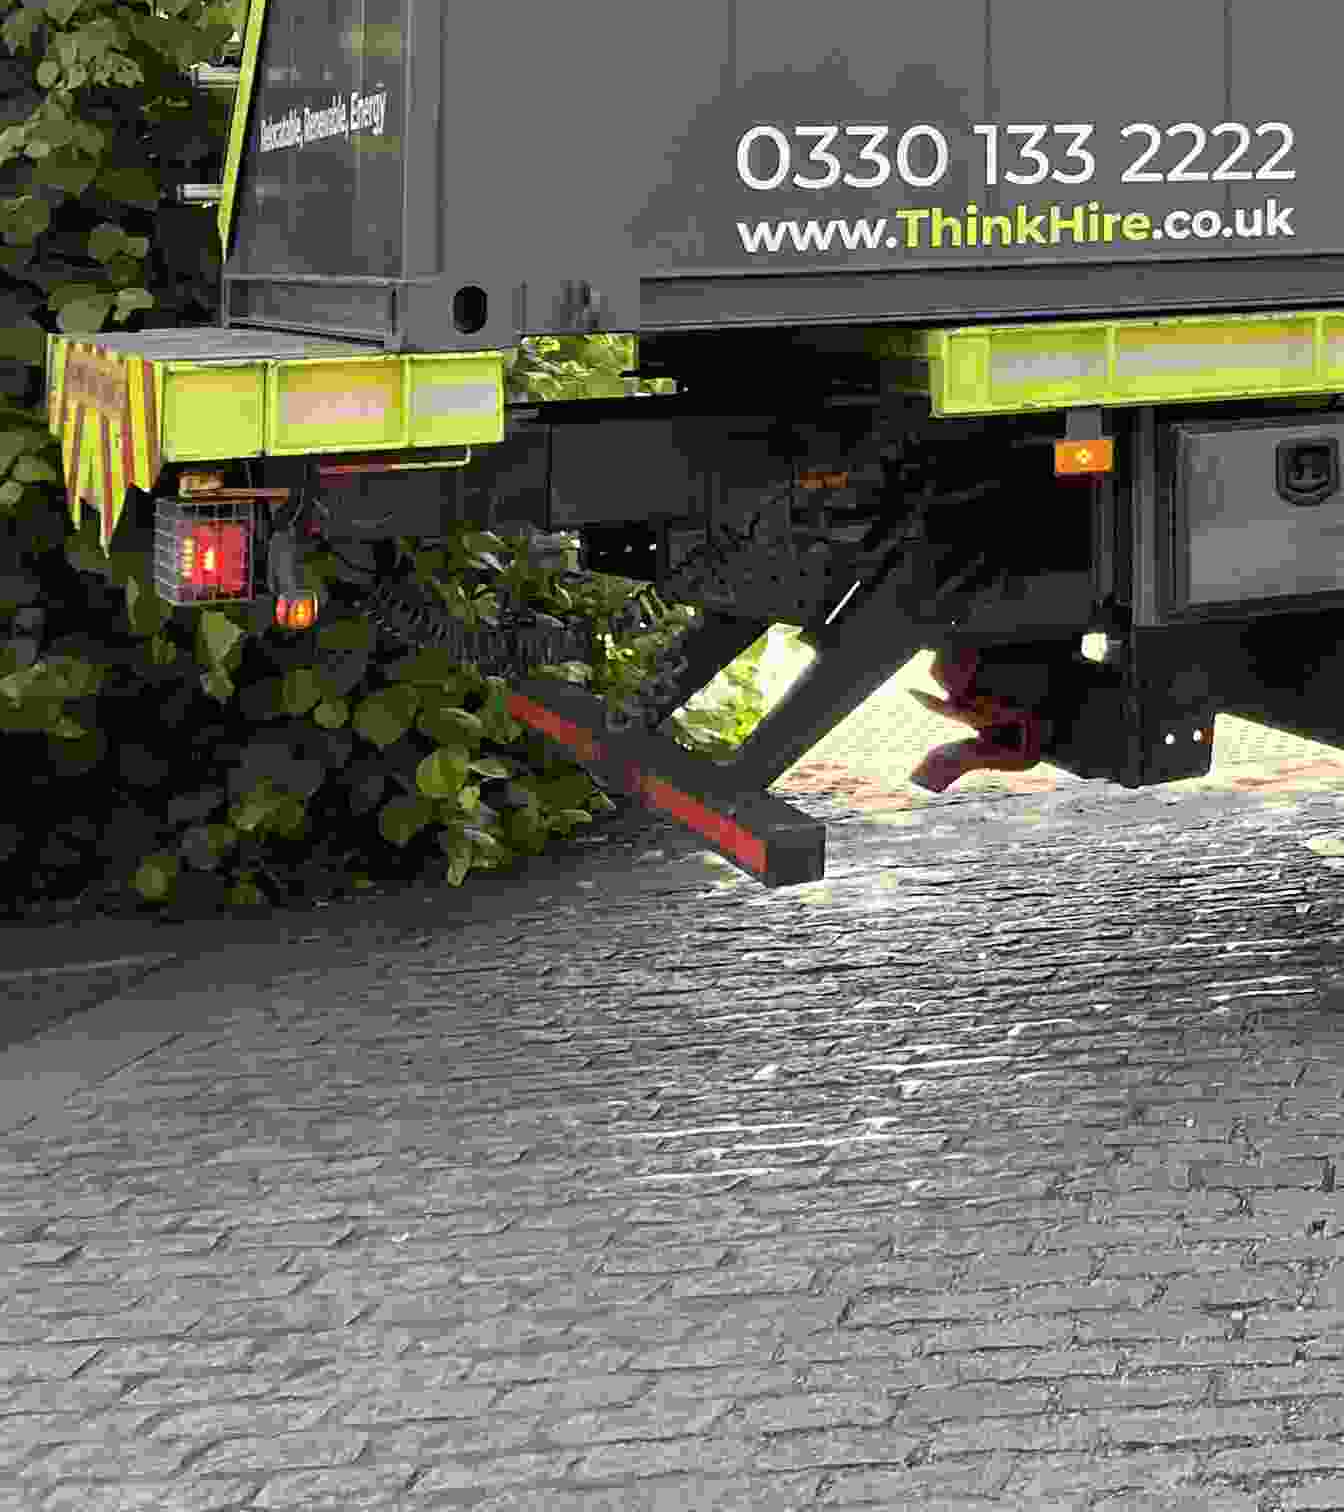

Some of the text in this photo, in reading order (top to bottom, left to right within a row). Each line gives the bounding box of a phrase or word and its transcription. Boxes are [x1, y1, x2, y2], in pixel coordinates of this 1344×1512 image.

[736, 121, 1296, 190] 0330 133 2222
[736, 199, 1296, 252] www.ThinkHire.co.uk
